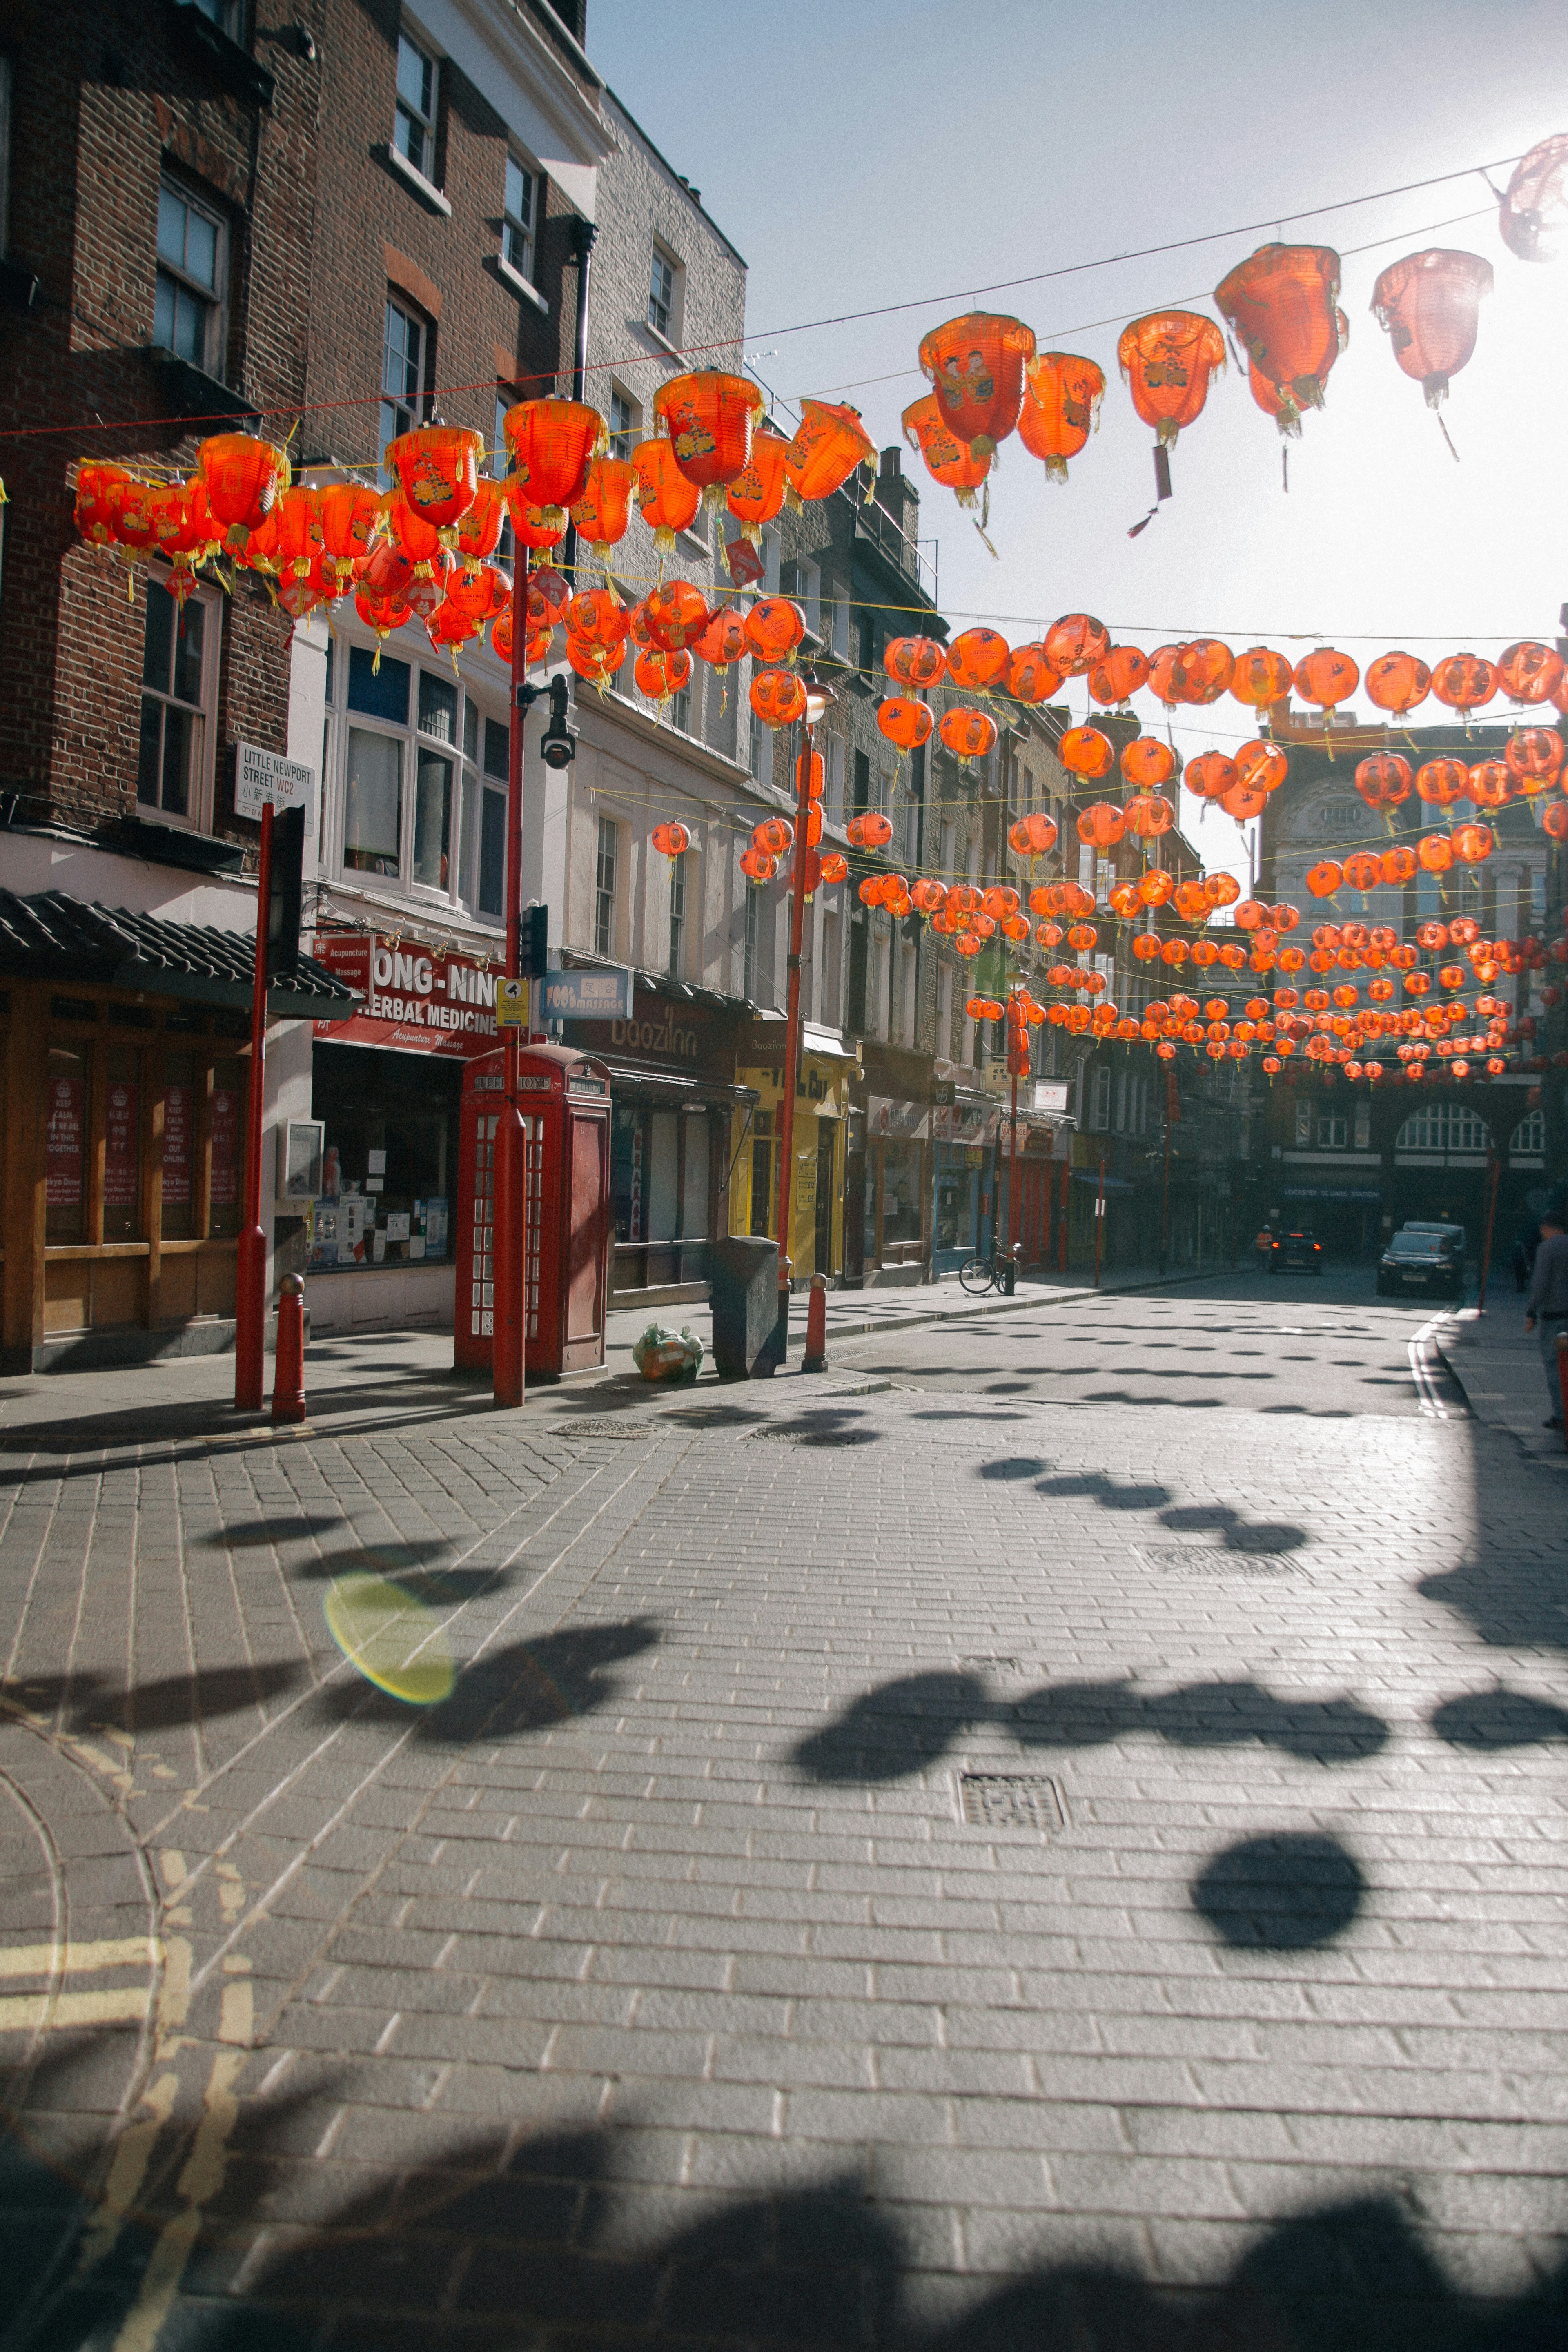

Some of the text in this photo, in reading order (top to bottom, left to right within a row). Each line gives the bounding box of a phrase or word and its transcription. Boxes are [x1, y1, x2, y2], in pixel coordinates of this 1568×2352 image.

[244, 749, 311, 784] LITTLE NEWPORT
[243, 766, 294, 795] STREET WC2
[242, 806, 250, 814] CITY
[330, 949, 368, 958] Acupuncture
[335, 968, 361, 978] Massage
[427, 1003, 498, 1036] MEDICINE
[392, 1028, 463, 1052] Acupunture Massage
[56, 1099, 72, 1108] KEEP
[55, 1110, 73, 1119] CALM
[168, 1106, 183, 1114] KEEP
[167, 1116, 183, 1125] CALM
[68, 1122, 80, 1131] ALL
[50, 1133, 75, 1142] IN THIS
[166, 1134, 183, 1143] HANG
[47, 1143, 79, 1153] TOGETHER
[163, 1155, 185, 1163] ONLINE
[47, 1178, 62, 1187] okyo
